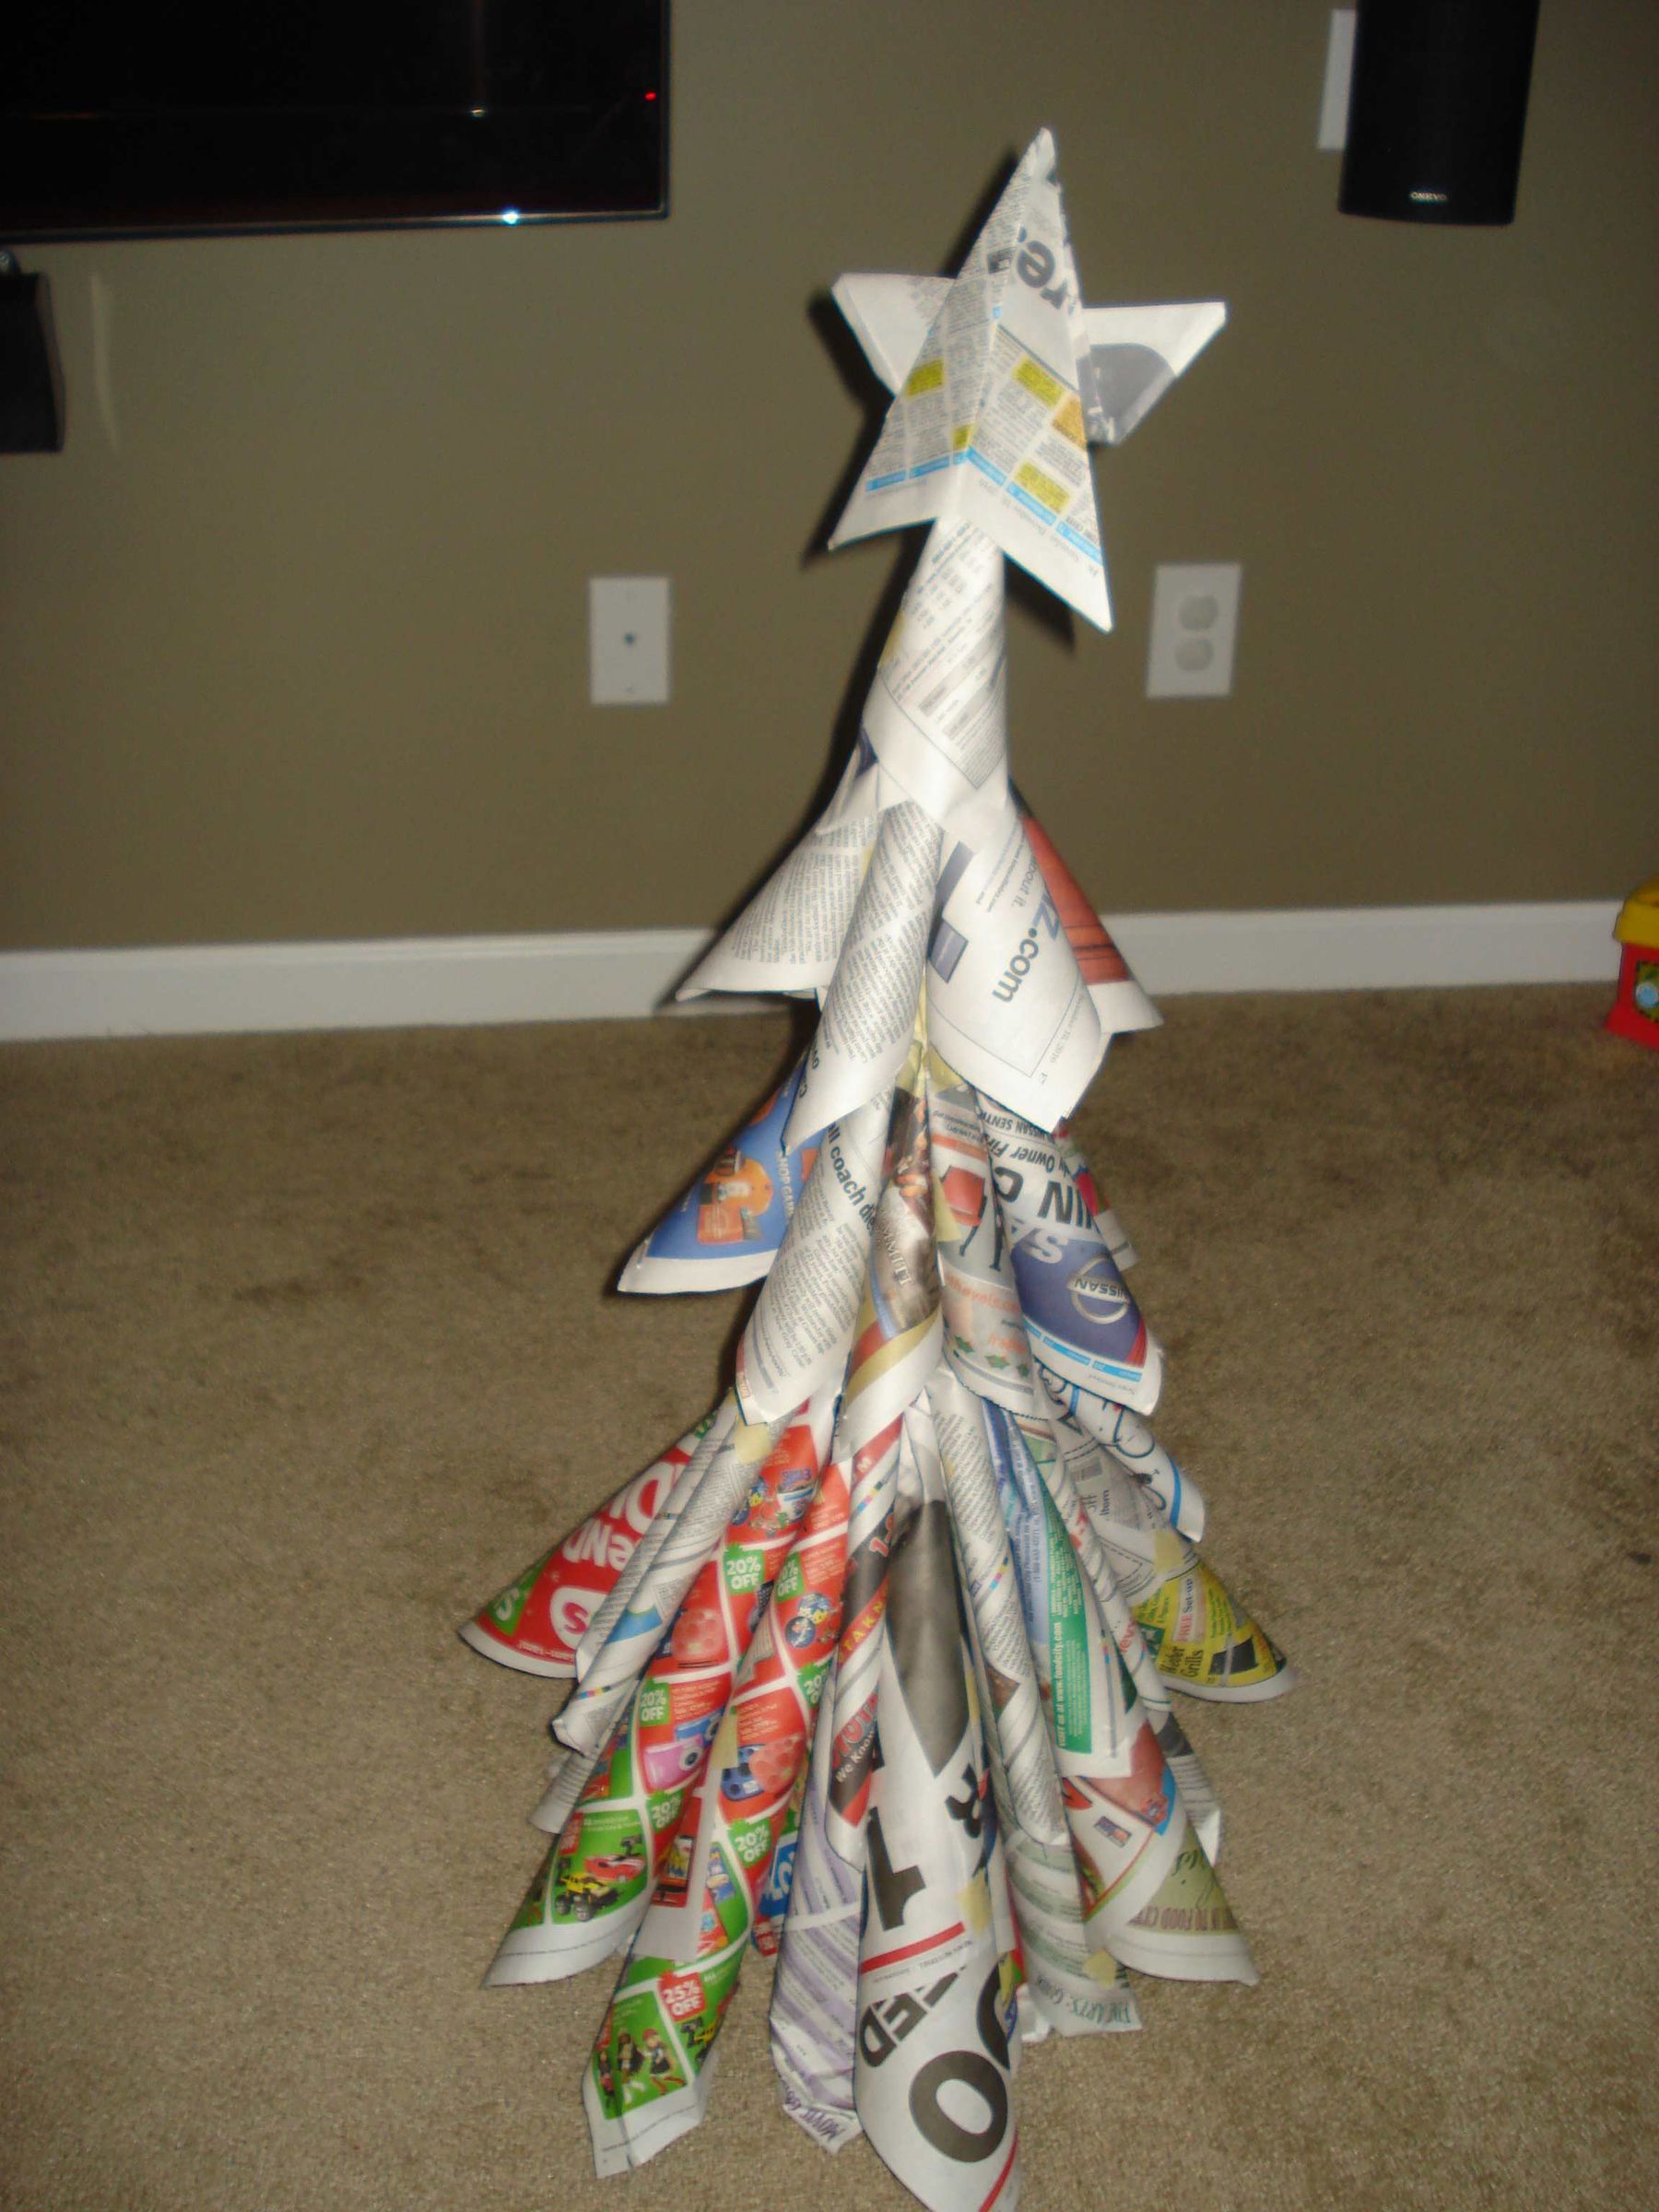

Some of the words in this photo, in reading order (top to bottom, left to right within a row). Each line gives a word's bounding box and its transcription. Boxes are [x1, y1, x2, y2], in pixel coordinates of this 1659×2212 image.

[1013, 1146, 1055, 1172] Owner
[830, 1146, 867, 1206] coach
[725, 1556, 761, 1576] 20%
[730, 1574, 760, 1591] OFF
[641, 1705, 665, 1723] OFF
[834, 1763, 854, 1783] We
[735, 1822, 771, 1849] 20%
[743, 1839, 769, 1863] OFF
[662, 1979, 701, 2005] 25%
[669, 1995, 701, 2020] OFF
